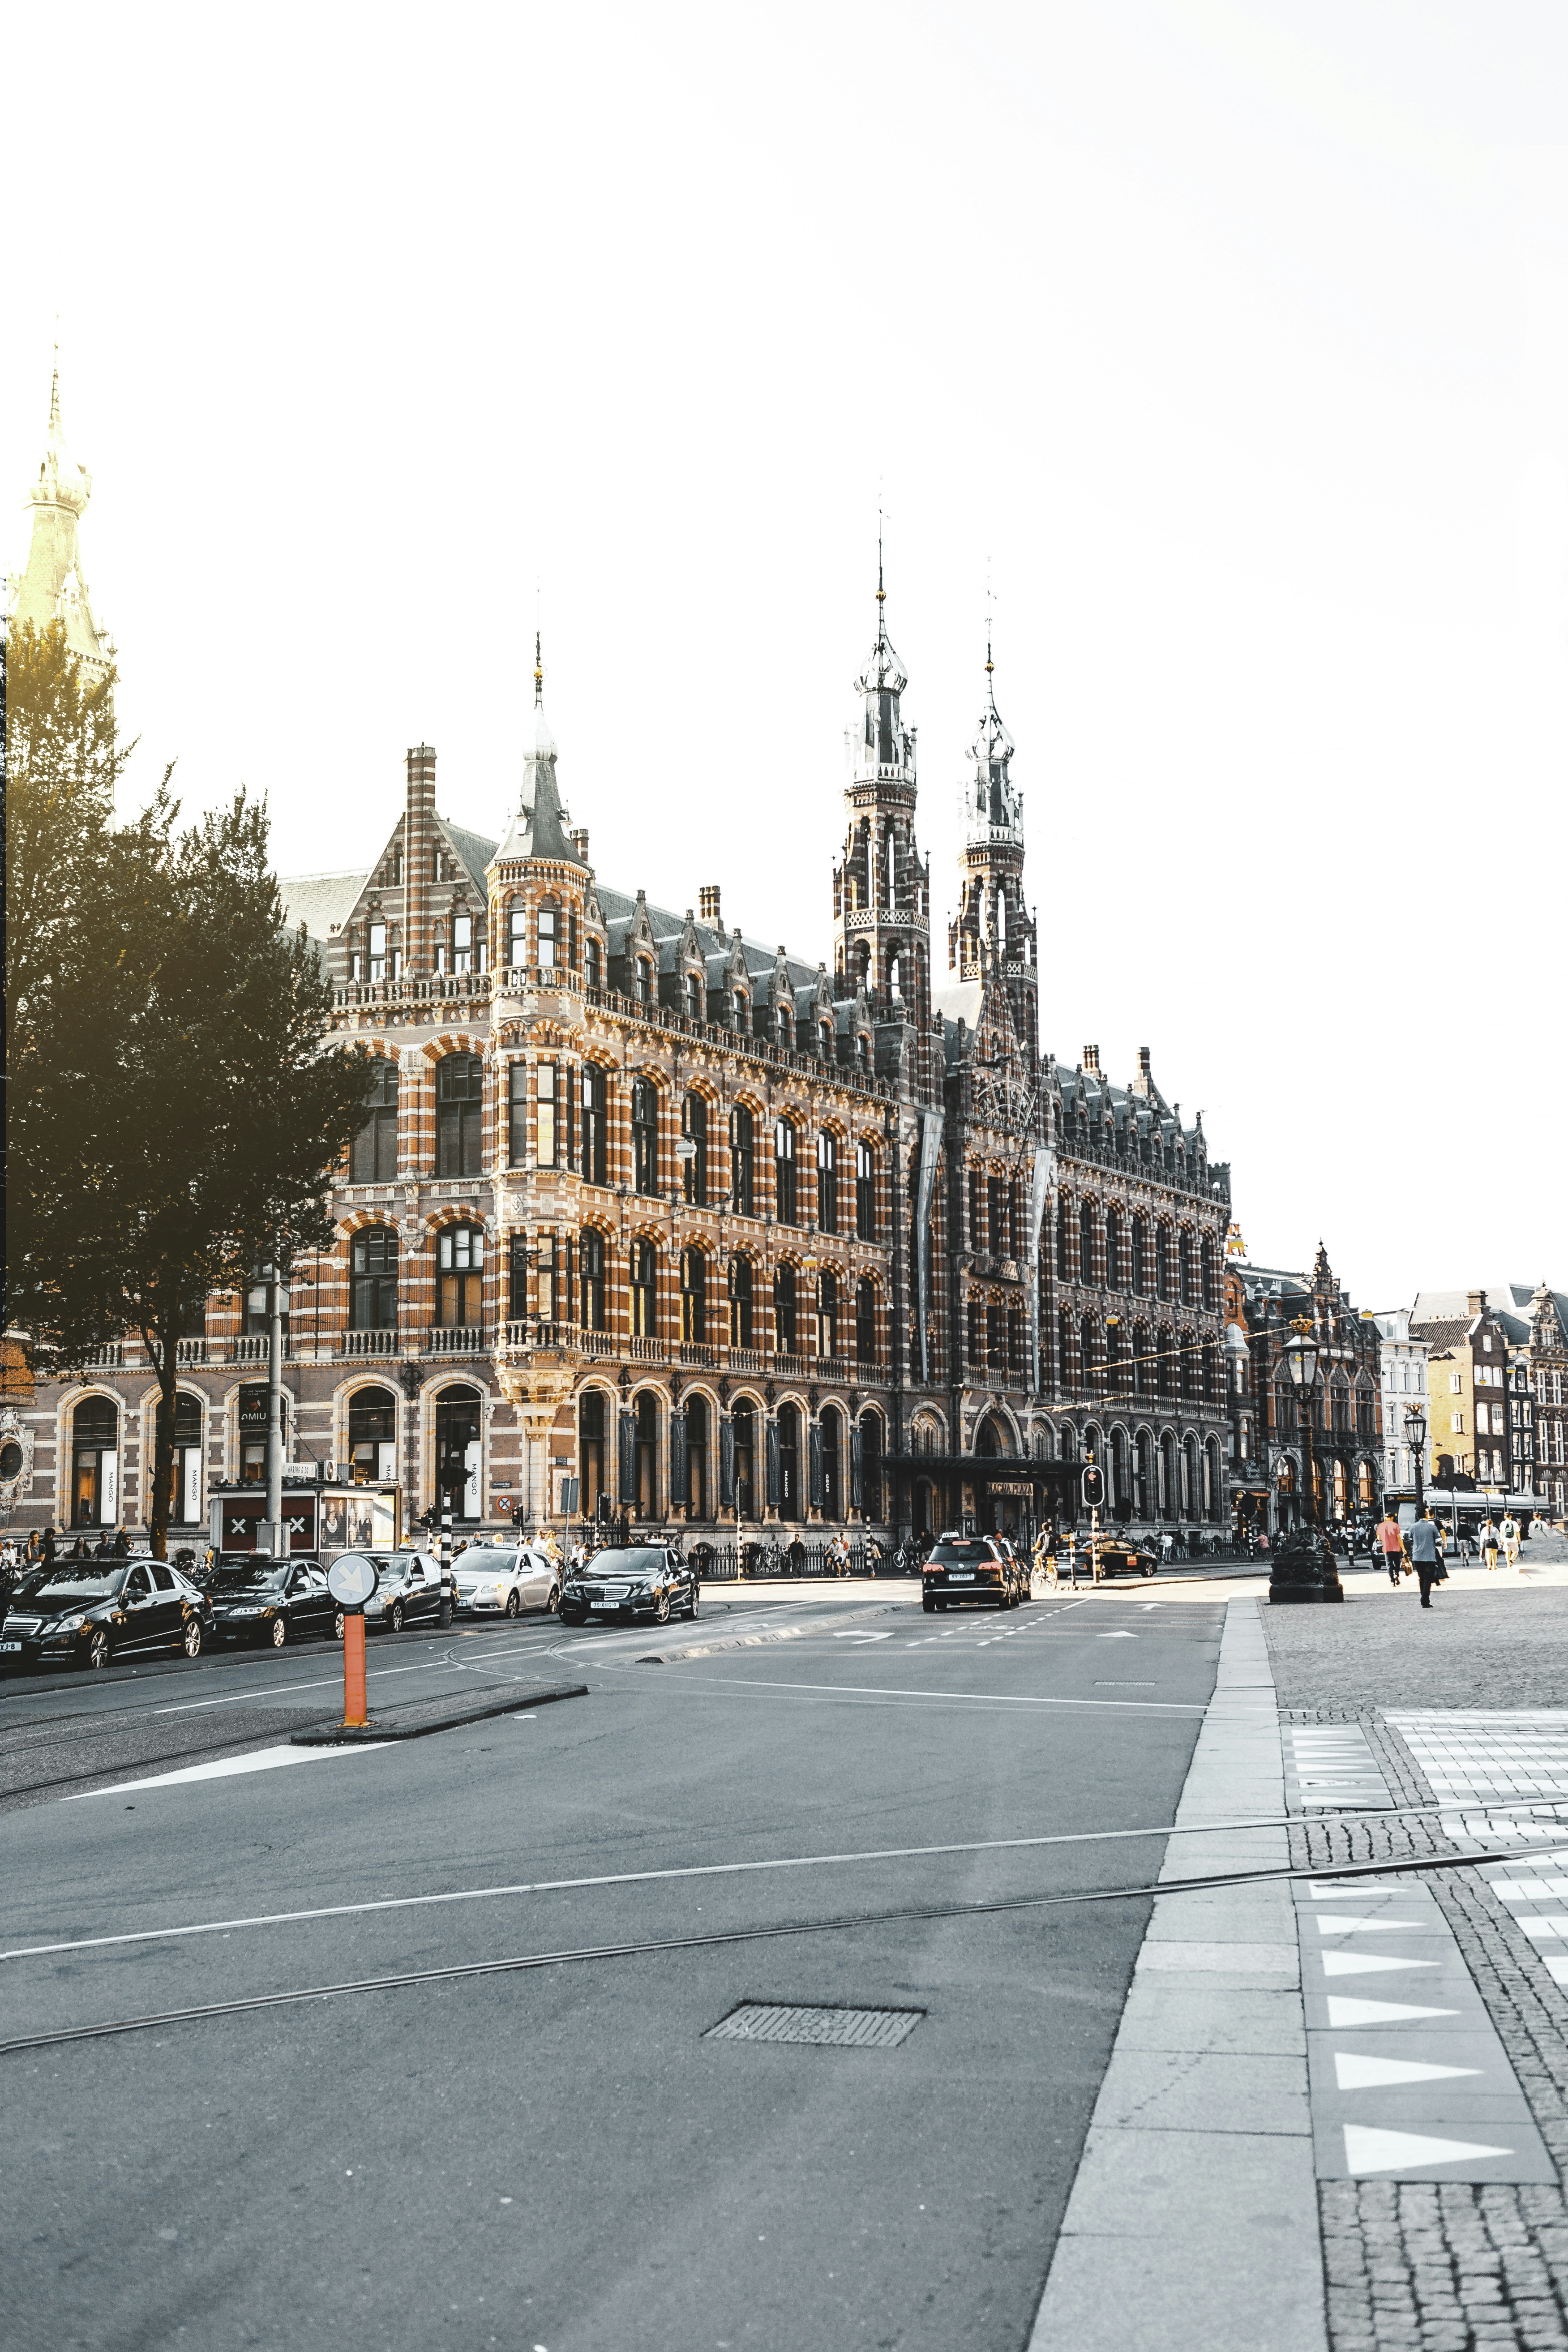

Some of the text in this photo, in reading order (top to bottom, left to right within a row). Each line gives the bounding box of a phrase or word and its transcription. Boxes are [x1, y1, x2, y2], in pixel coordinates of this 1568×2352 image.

[248, 1412, 266, 1420] MIU
[986, 1482, 1032, 1495] MAGNA PLAZA
